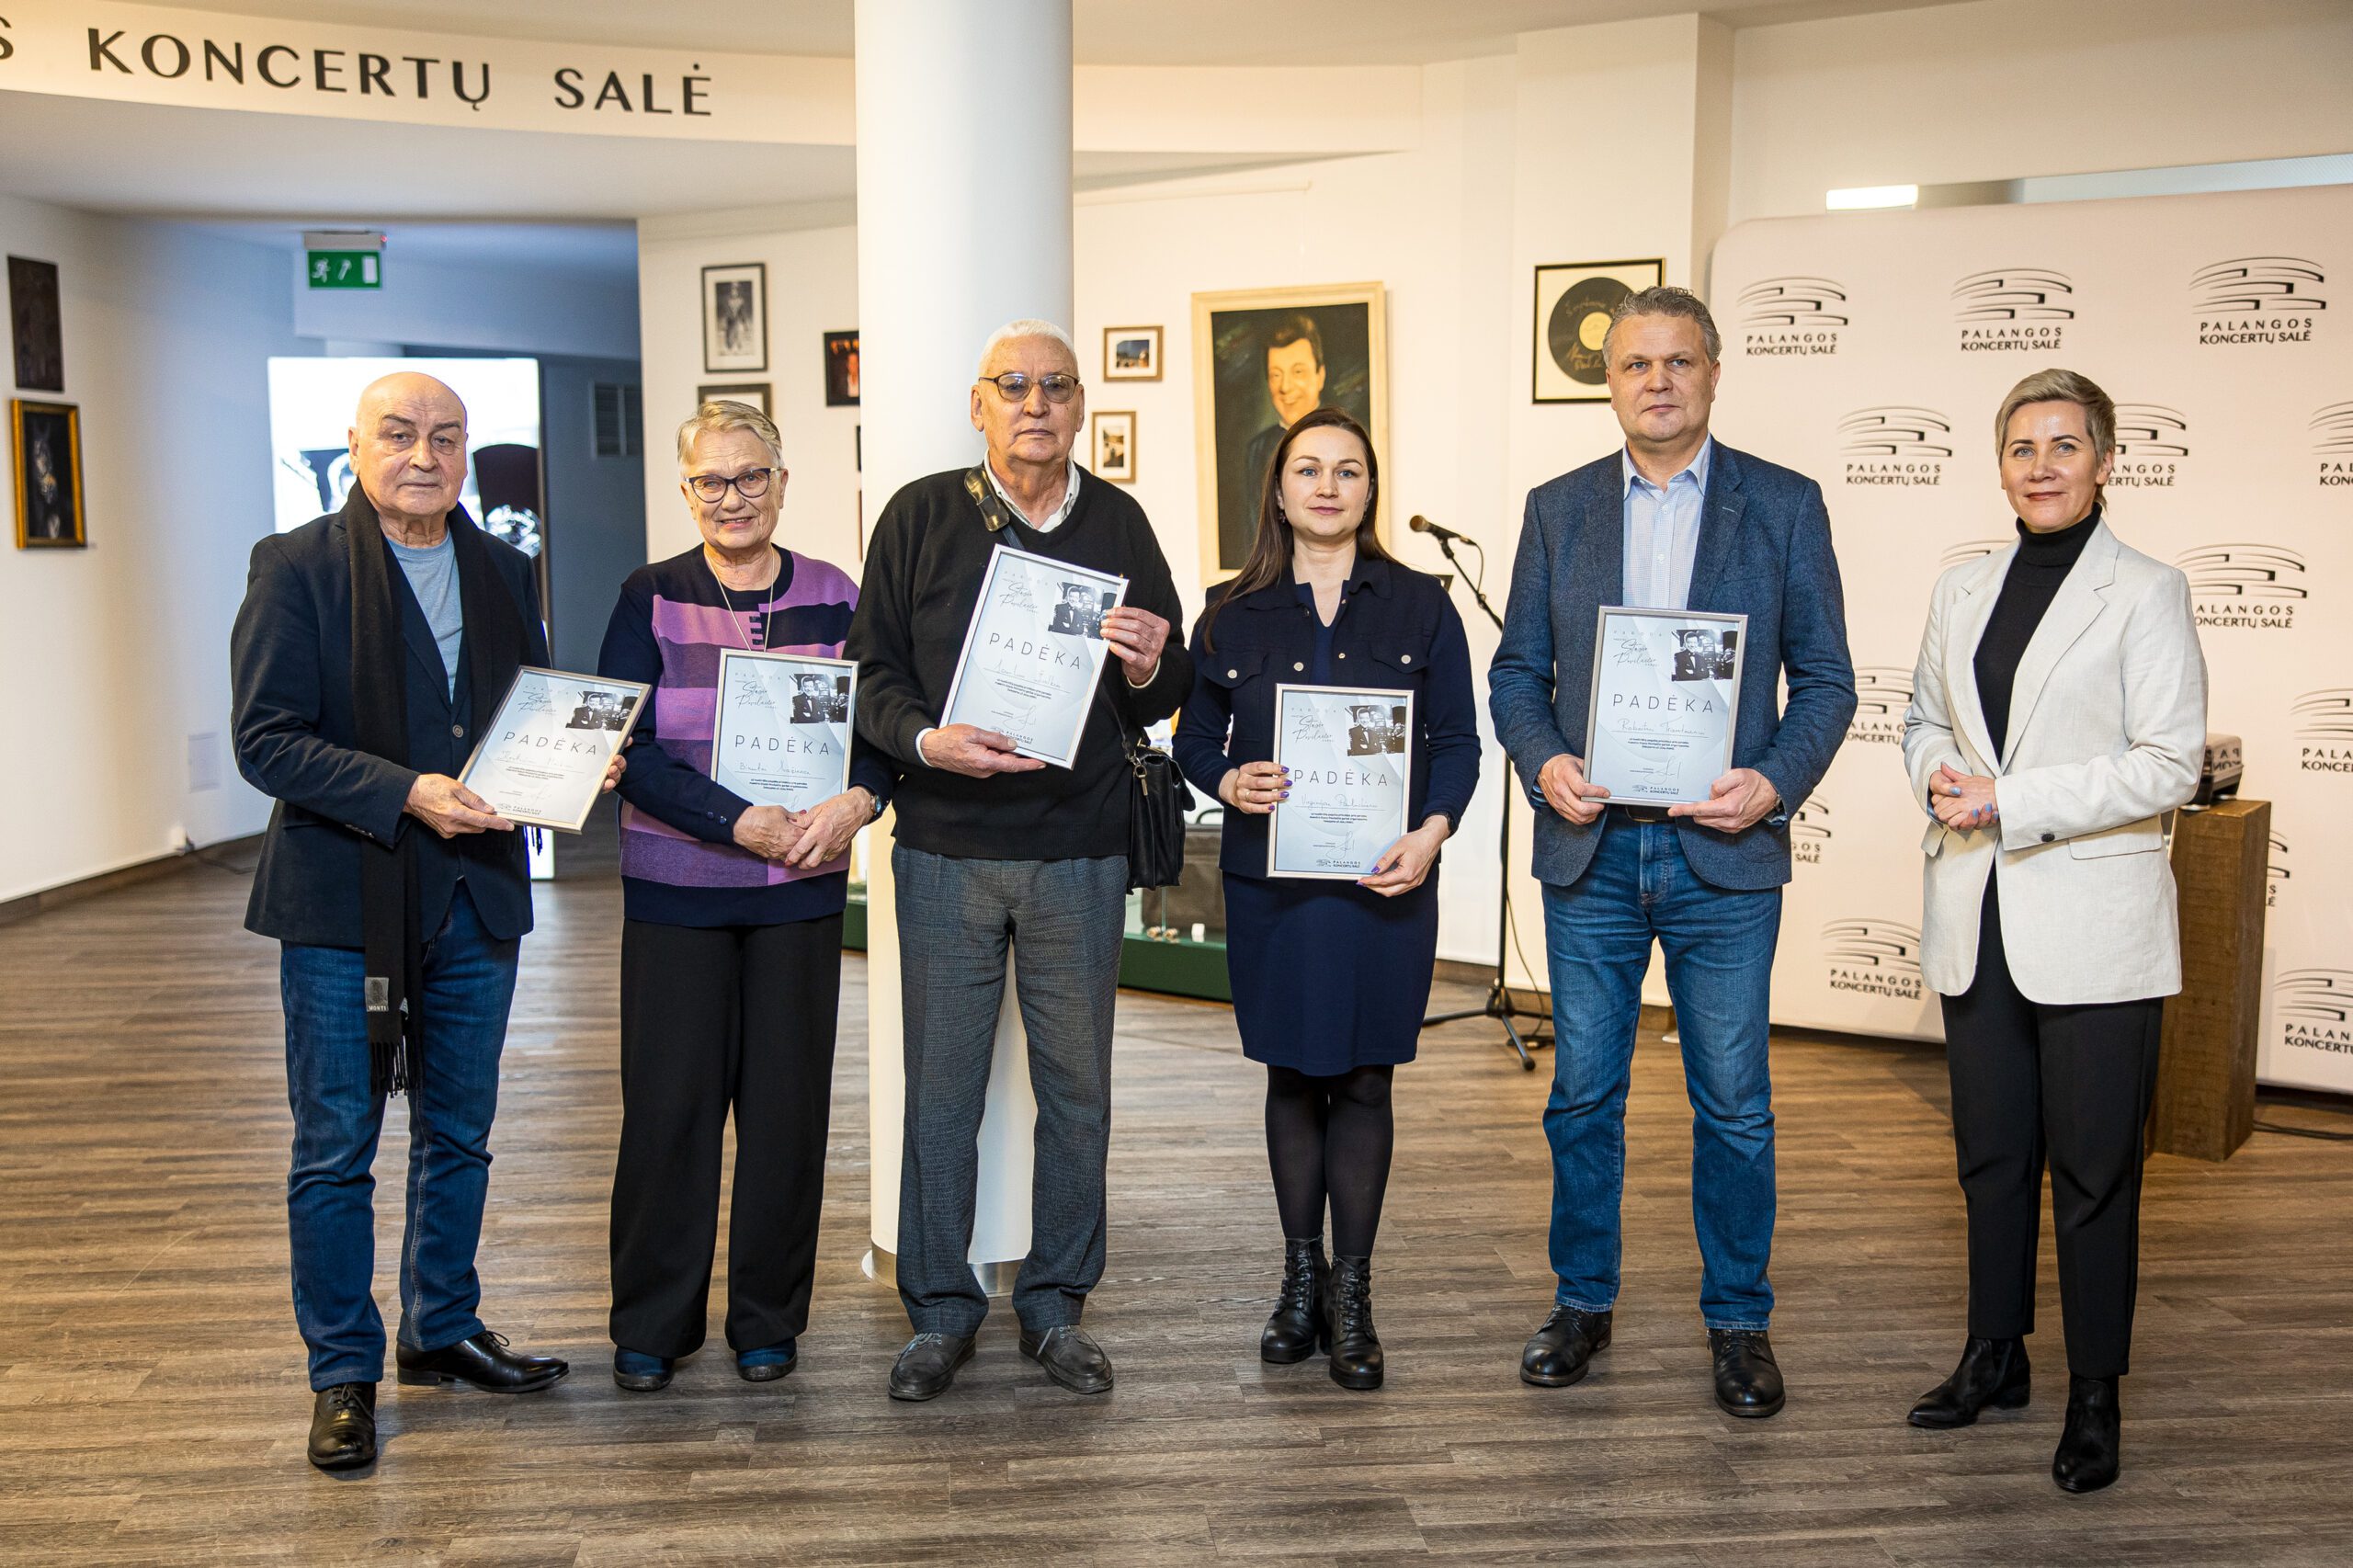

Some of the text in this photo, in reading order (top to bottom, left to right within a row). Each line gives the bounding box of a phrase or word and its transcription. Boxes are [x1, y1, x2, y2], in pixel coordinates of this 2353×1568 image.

[86, 27, 492, 111] KONCERTŲ
[553, 63, 713, 117] SALĖ
[2200, 318, 2313, 332] PALANGOS
[1746, 333, 1837, 344] PALANGOS
[1961, 327, 2063, 340] PALANGOS
[2199, 330, 2312, 345] KONCERTŲ SALĖ
[1746, 344, 1836, 356] KONCERTŲ SALĖ
[1961, 338, 2062, 352] KONCERTŲ SALĖ
[1846, 463, 1941, 473] PALANGOS
[1846, 474, 1940, 487] KONCERTŲ SALĖ
[2143, 475, 2176, 486] SALĖ
[2319, 475, 2353, 486] KON
[2260, 617, 2293, 629] SALĖ
[989, 632, 1081, 670] PADĖKA
[1612, 693, 1713, 714] PADĖKA
[504, 731, 597, 756] PADĖKA
[734, 734, 830, 756] PADĖKA
[2301, 760, 2353, 773] KONCE
[1293, 768, 1388, 787] PADĖKA
[1830, 969, 1922, 989] PALANGOS
[1829, 980, 1892, 997] KONCERTŲ
[2285, 1022, 2350, 1041] PALAN
